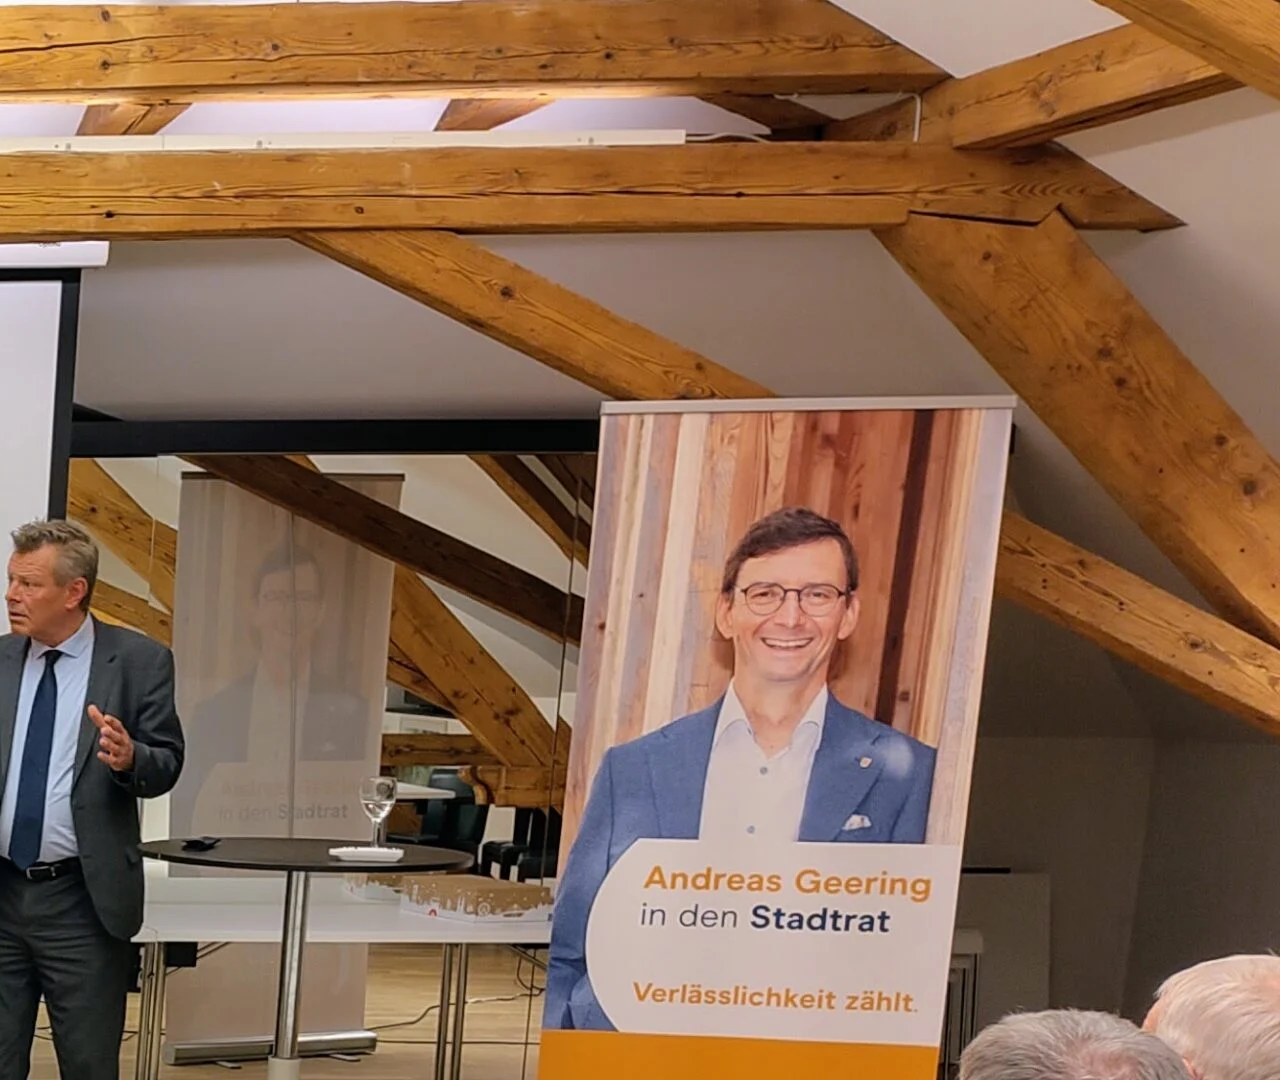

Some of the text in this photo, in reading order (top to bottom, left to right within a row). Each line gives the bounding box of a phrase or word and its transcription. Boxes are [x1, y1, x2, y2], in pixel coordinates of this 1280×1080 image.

[278, 802, 349, 820] Sadtrat
[643, 865, 932, 903] Andreas Geering
[640, 902, 891, 933] in den Stadtrat
[633, 981, 918, 1013] Verlässlichkeit zählt.
